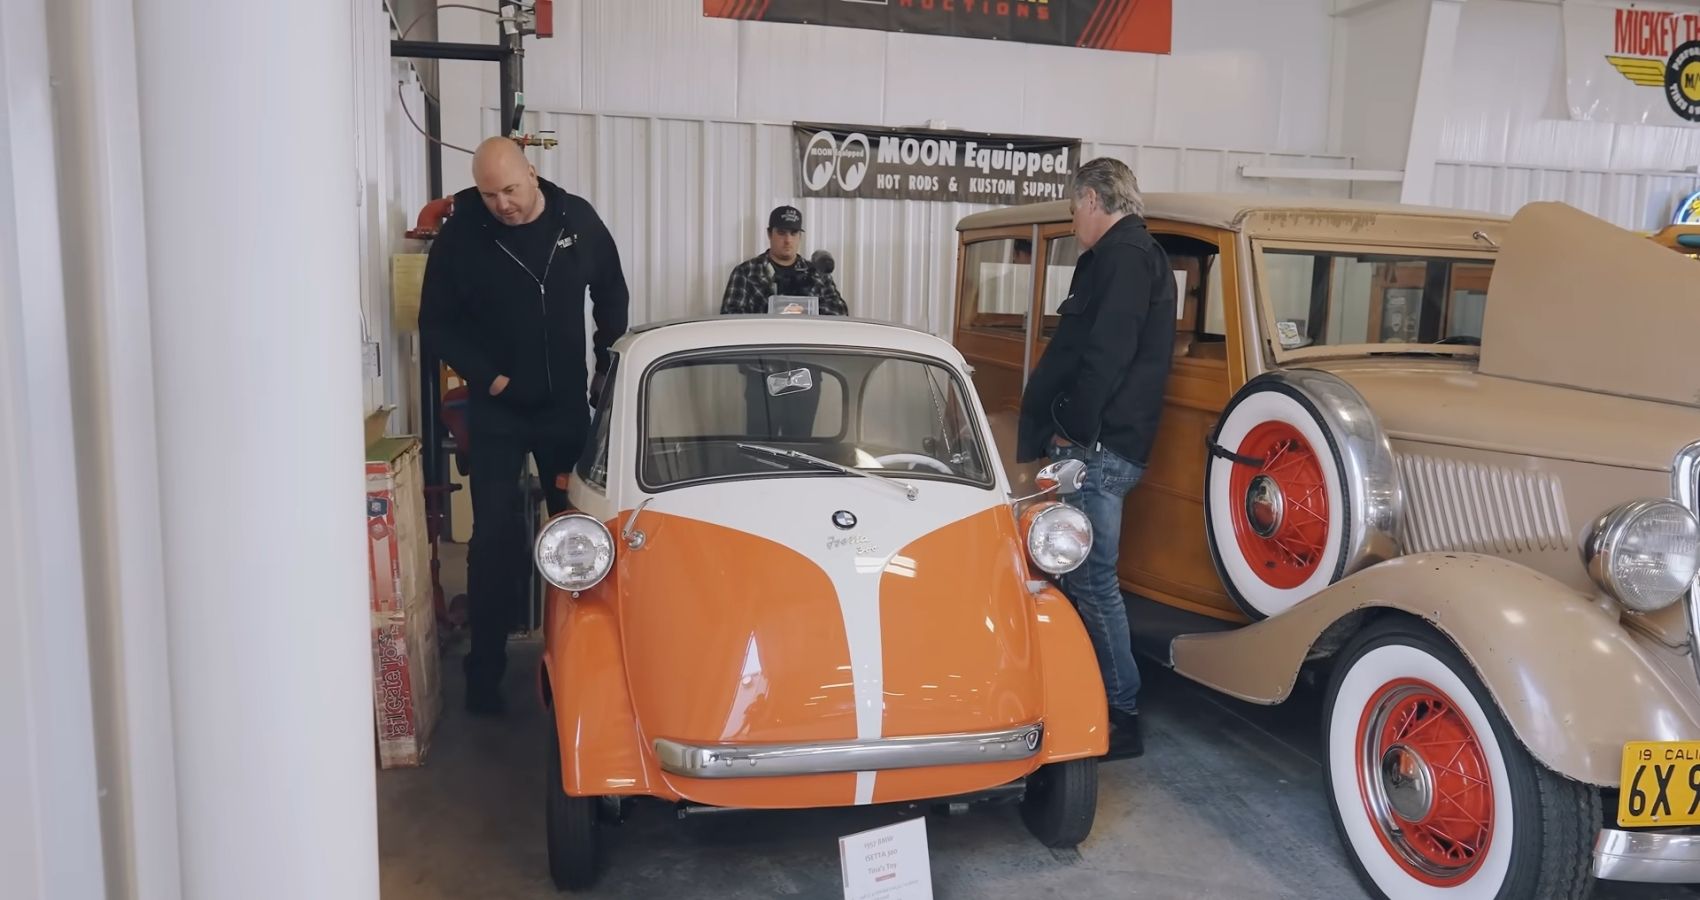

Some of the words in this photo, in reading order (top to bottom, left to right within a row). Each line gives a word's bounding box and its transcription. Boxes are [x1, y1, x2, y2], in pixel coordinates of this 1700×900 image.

[1614, 9, 1680, 57] MICKEY
[811, 148, 832, 156] MOON
[877, 136, 957, 167] MOON
[877, 174, 900, 190] HOT
[908, 175, 939, 191] RODS
[948, 176, 958, 192] &
[969, 177, 1016, 195] KUSTOM
[1022, 181, 1065, 199] SUPPLY
[1639, 749, 1652, 761] 19
[1664, 748, 1700, 761] CALI
[1628, 764, 1676, 817] 6X
[865, 851, 887, 862] ISETTA
